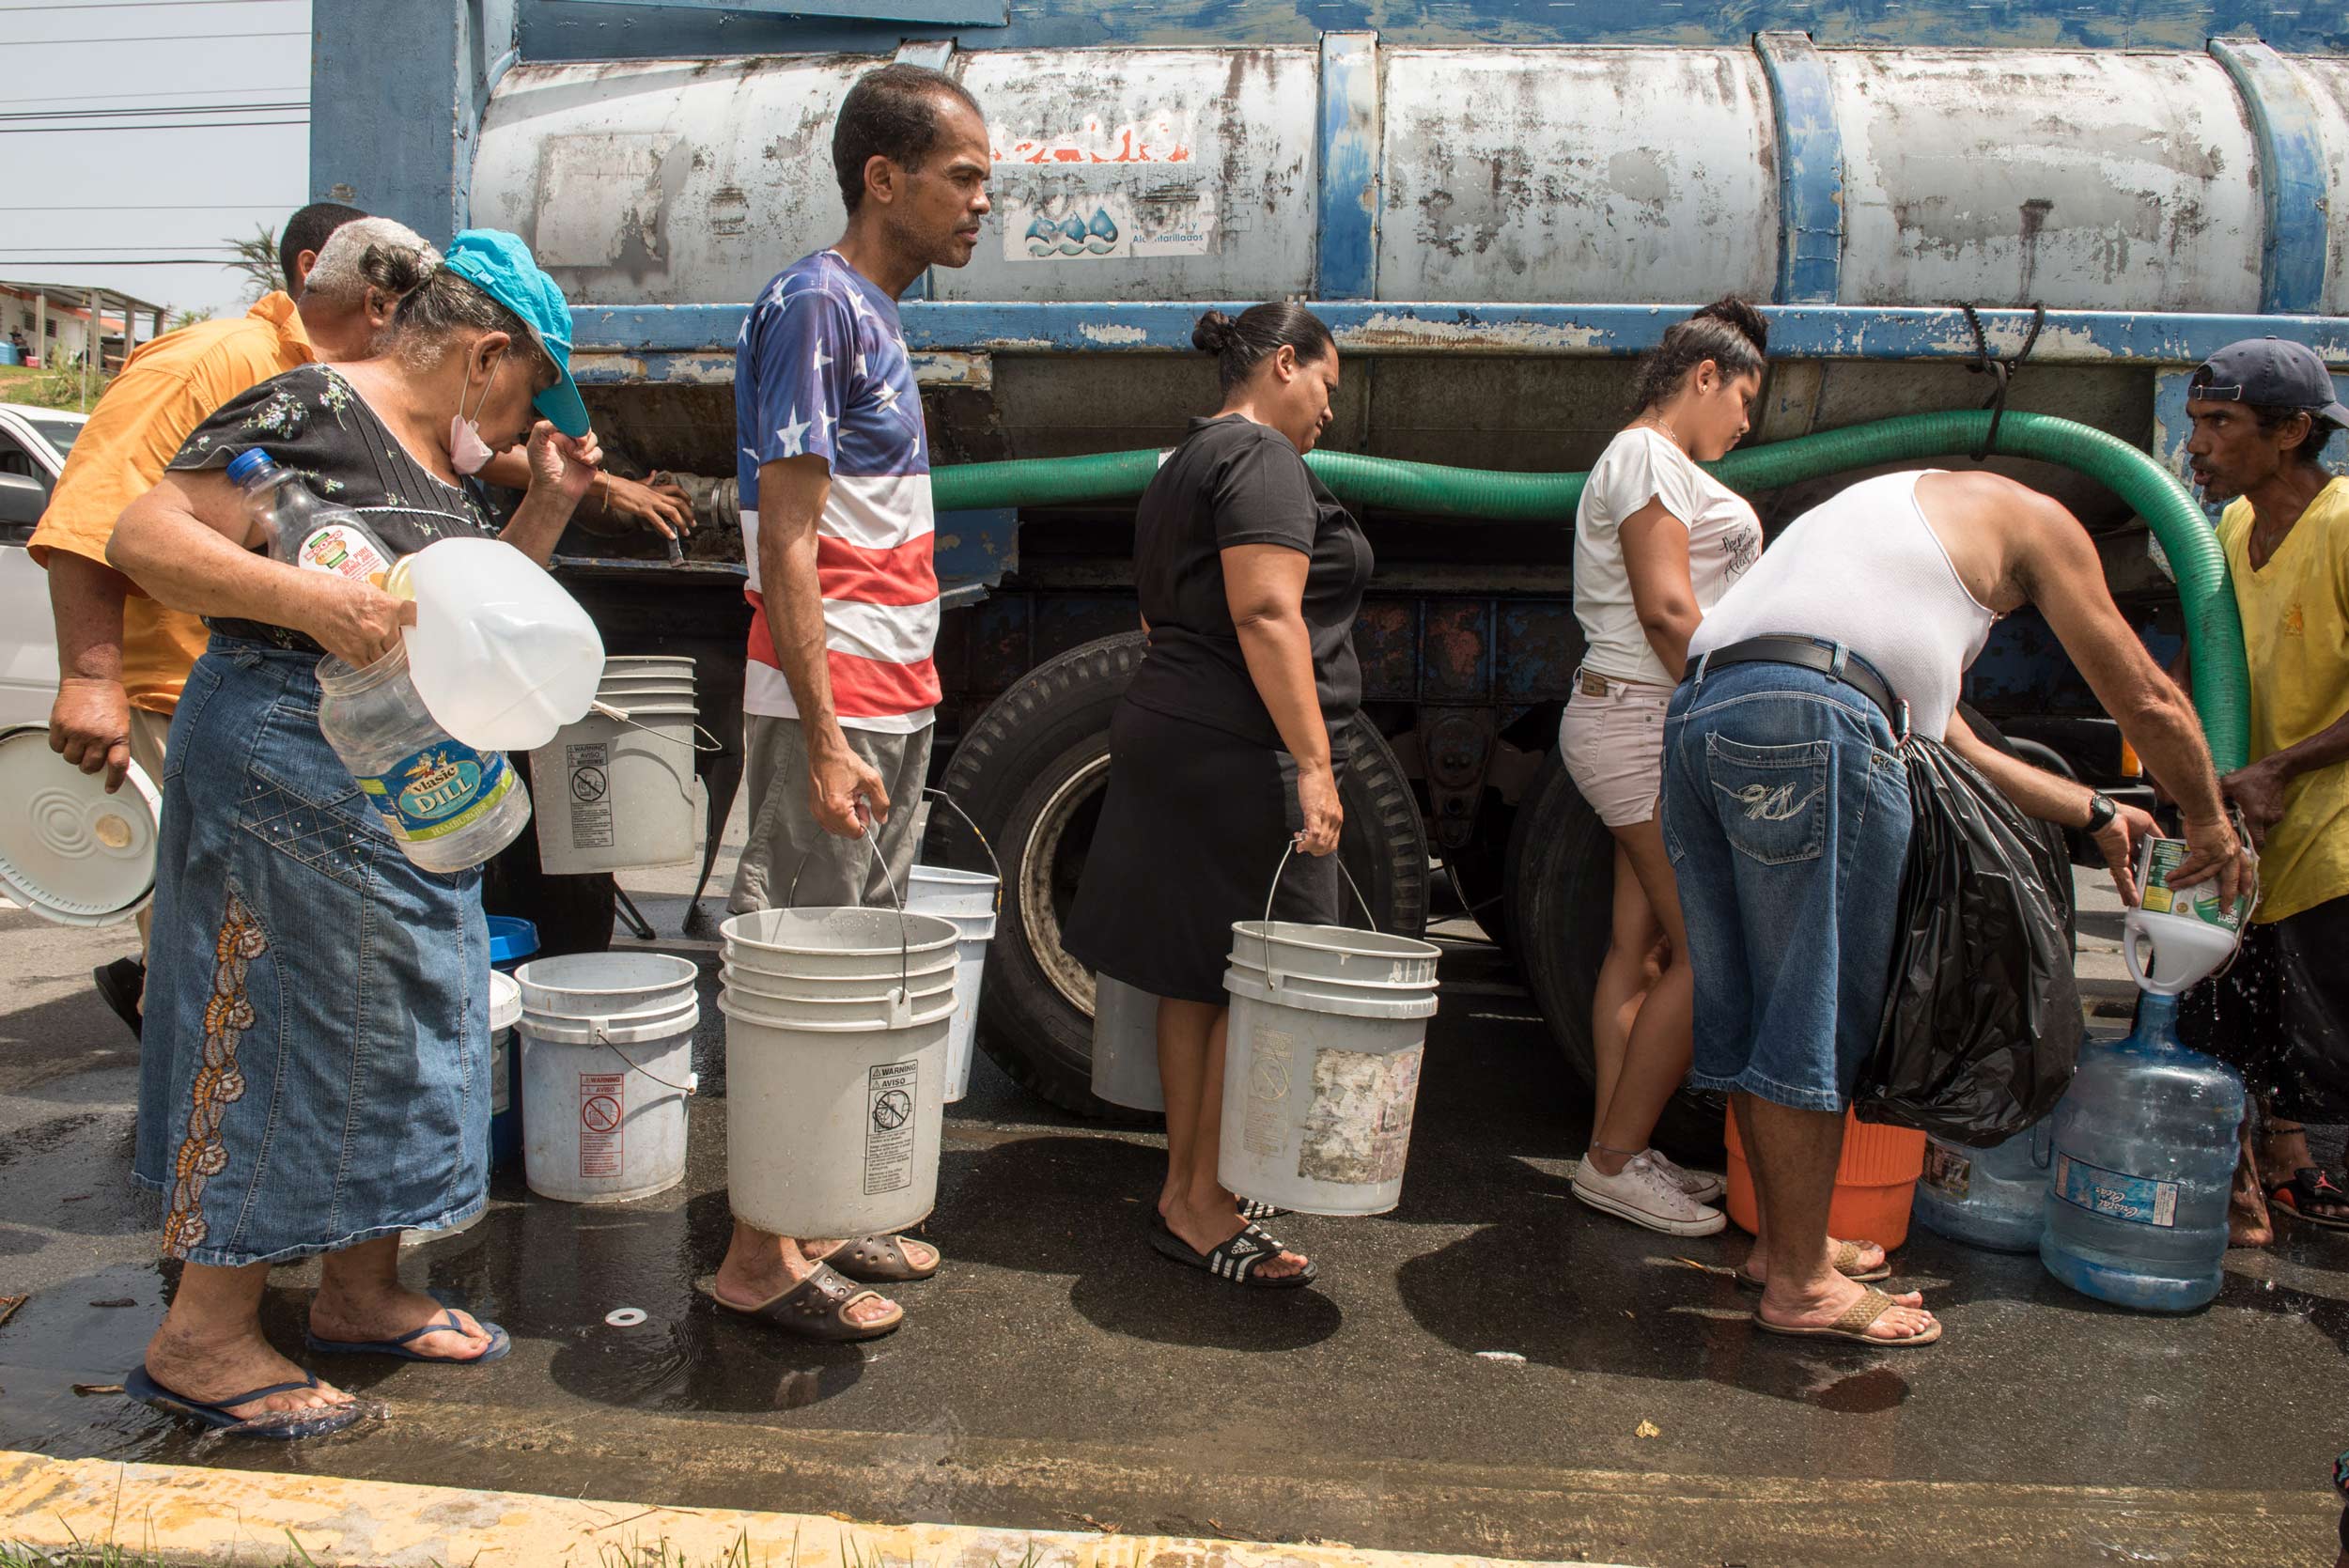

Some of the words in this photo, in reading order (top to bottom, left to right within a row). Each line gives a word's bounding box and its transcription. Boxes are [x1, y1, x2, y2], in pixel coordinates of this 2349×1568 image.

[353, 546, 370, 559] PURE
[574, 744, 605, 753] WARNING
[412, 766, 457, 794] vlasic
[413, 776, 474, 815] DILL
[431, 802, 489, 837] HAMBURGER
[881, 1063, 916, 1077] WARNING
[882, 1078, 906, 1088] AVISO
[1231, 1245, 1259, 1255] adidas
